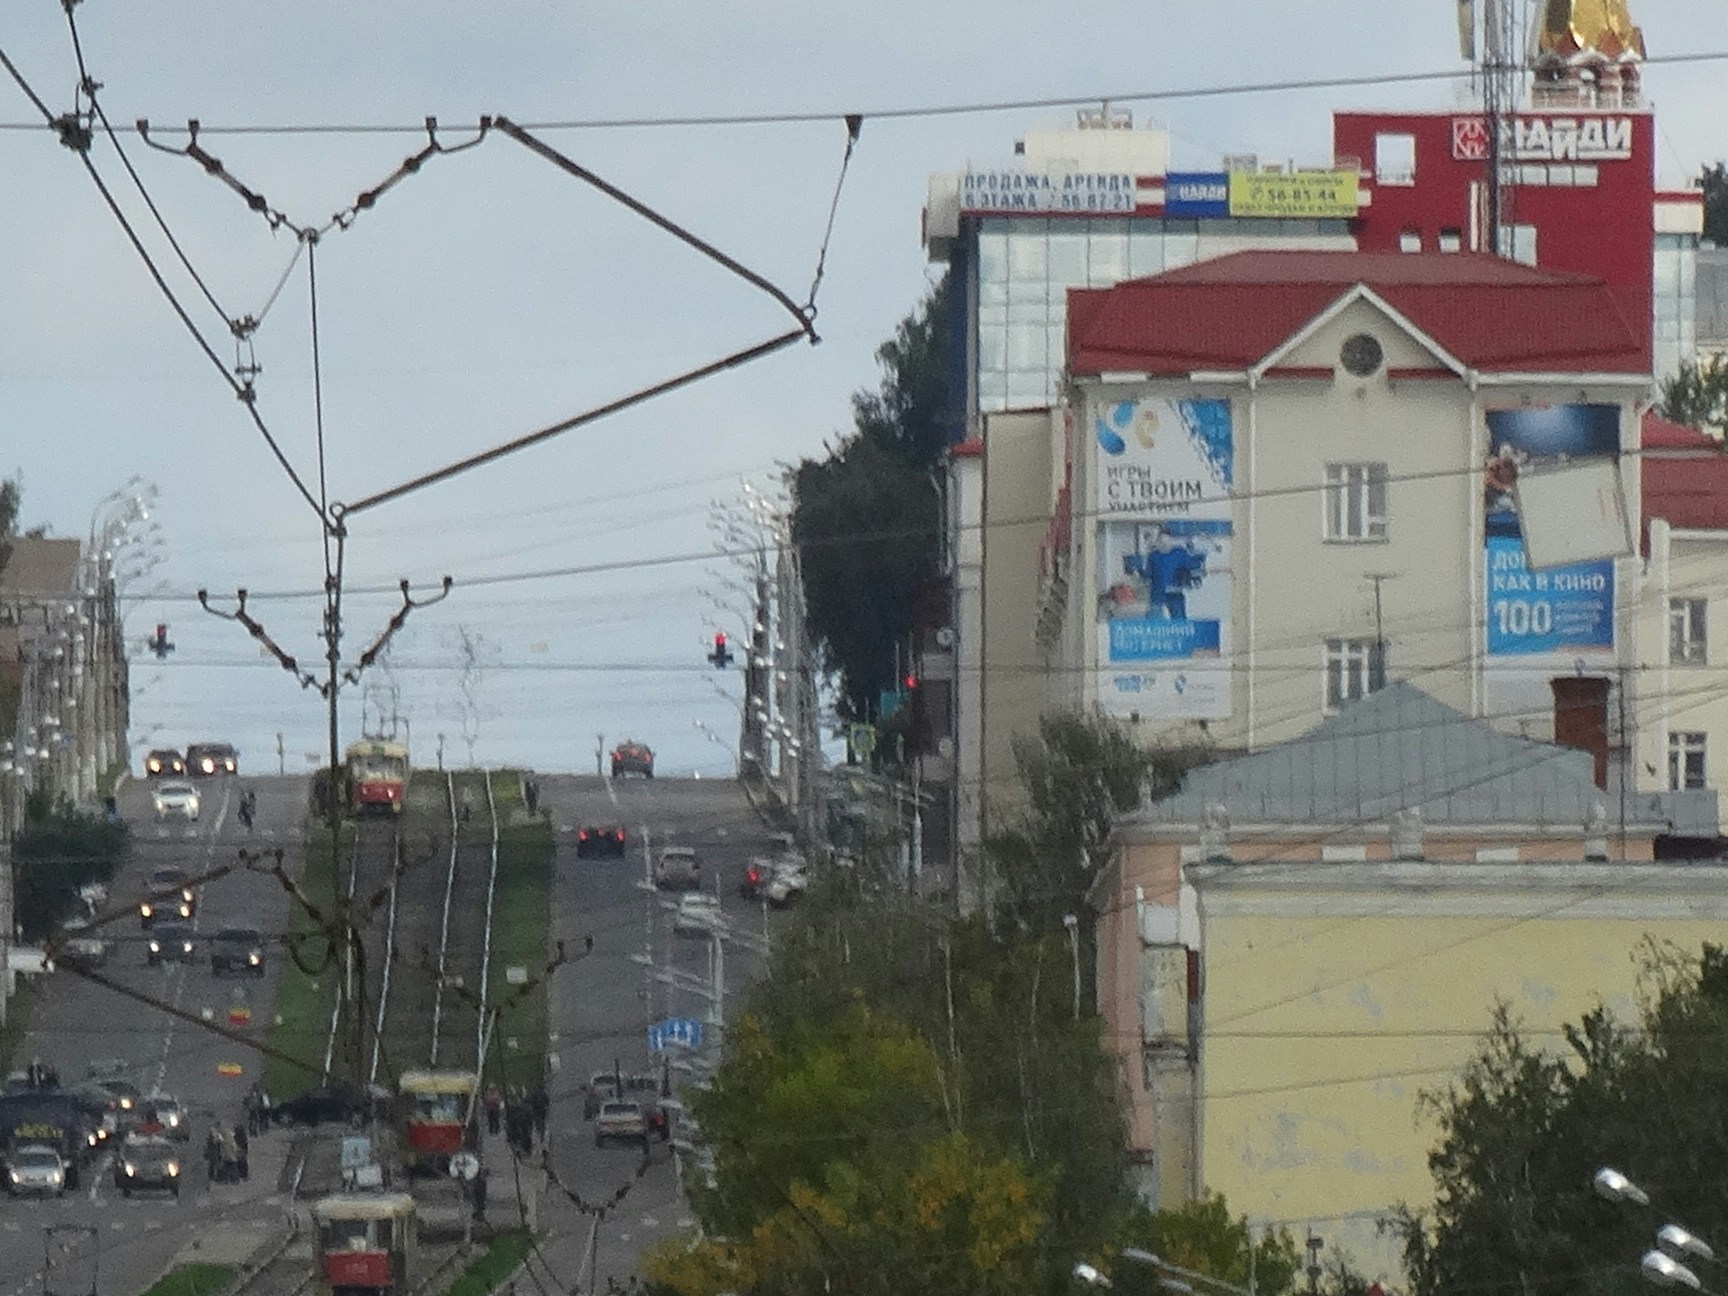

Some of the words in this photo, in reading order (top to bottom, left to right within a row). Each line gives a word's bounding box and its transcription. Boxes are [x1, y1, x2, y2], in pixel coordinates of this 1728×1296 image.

[1063, 173, 1131, 192] АРЕНДА
[1107, 465, 1151, 479] ИГРЫ
[1108, 481, 1121, 499] С
[1128, 479, 1203, 500] ТВОИМ
[1493, 573, 1531, 591] КАК
[1536, 573, 1548, 590] В
[1554, 573, 1606, 591] КИНО
[1495, 599, 1552, 634] 100
